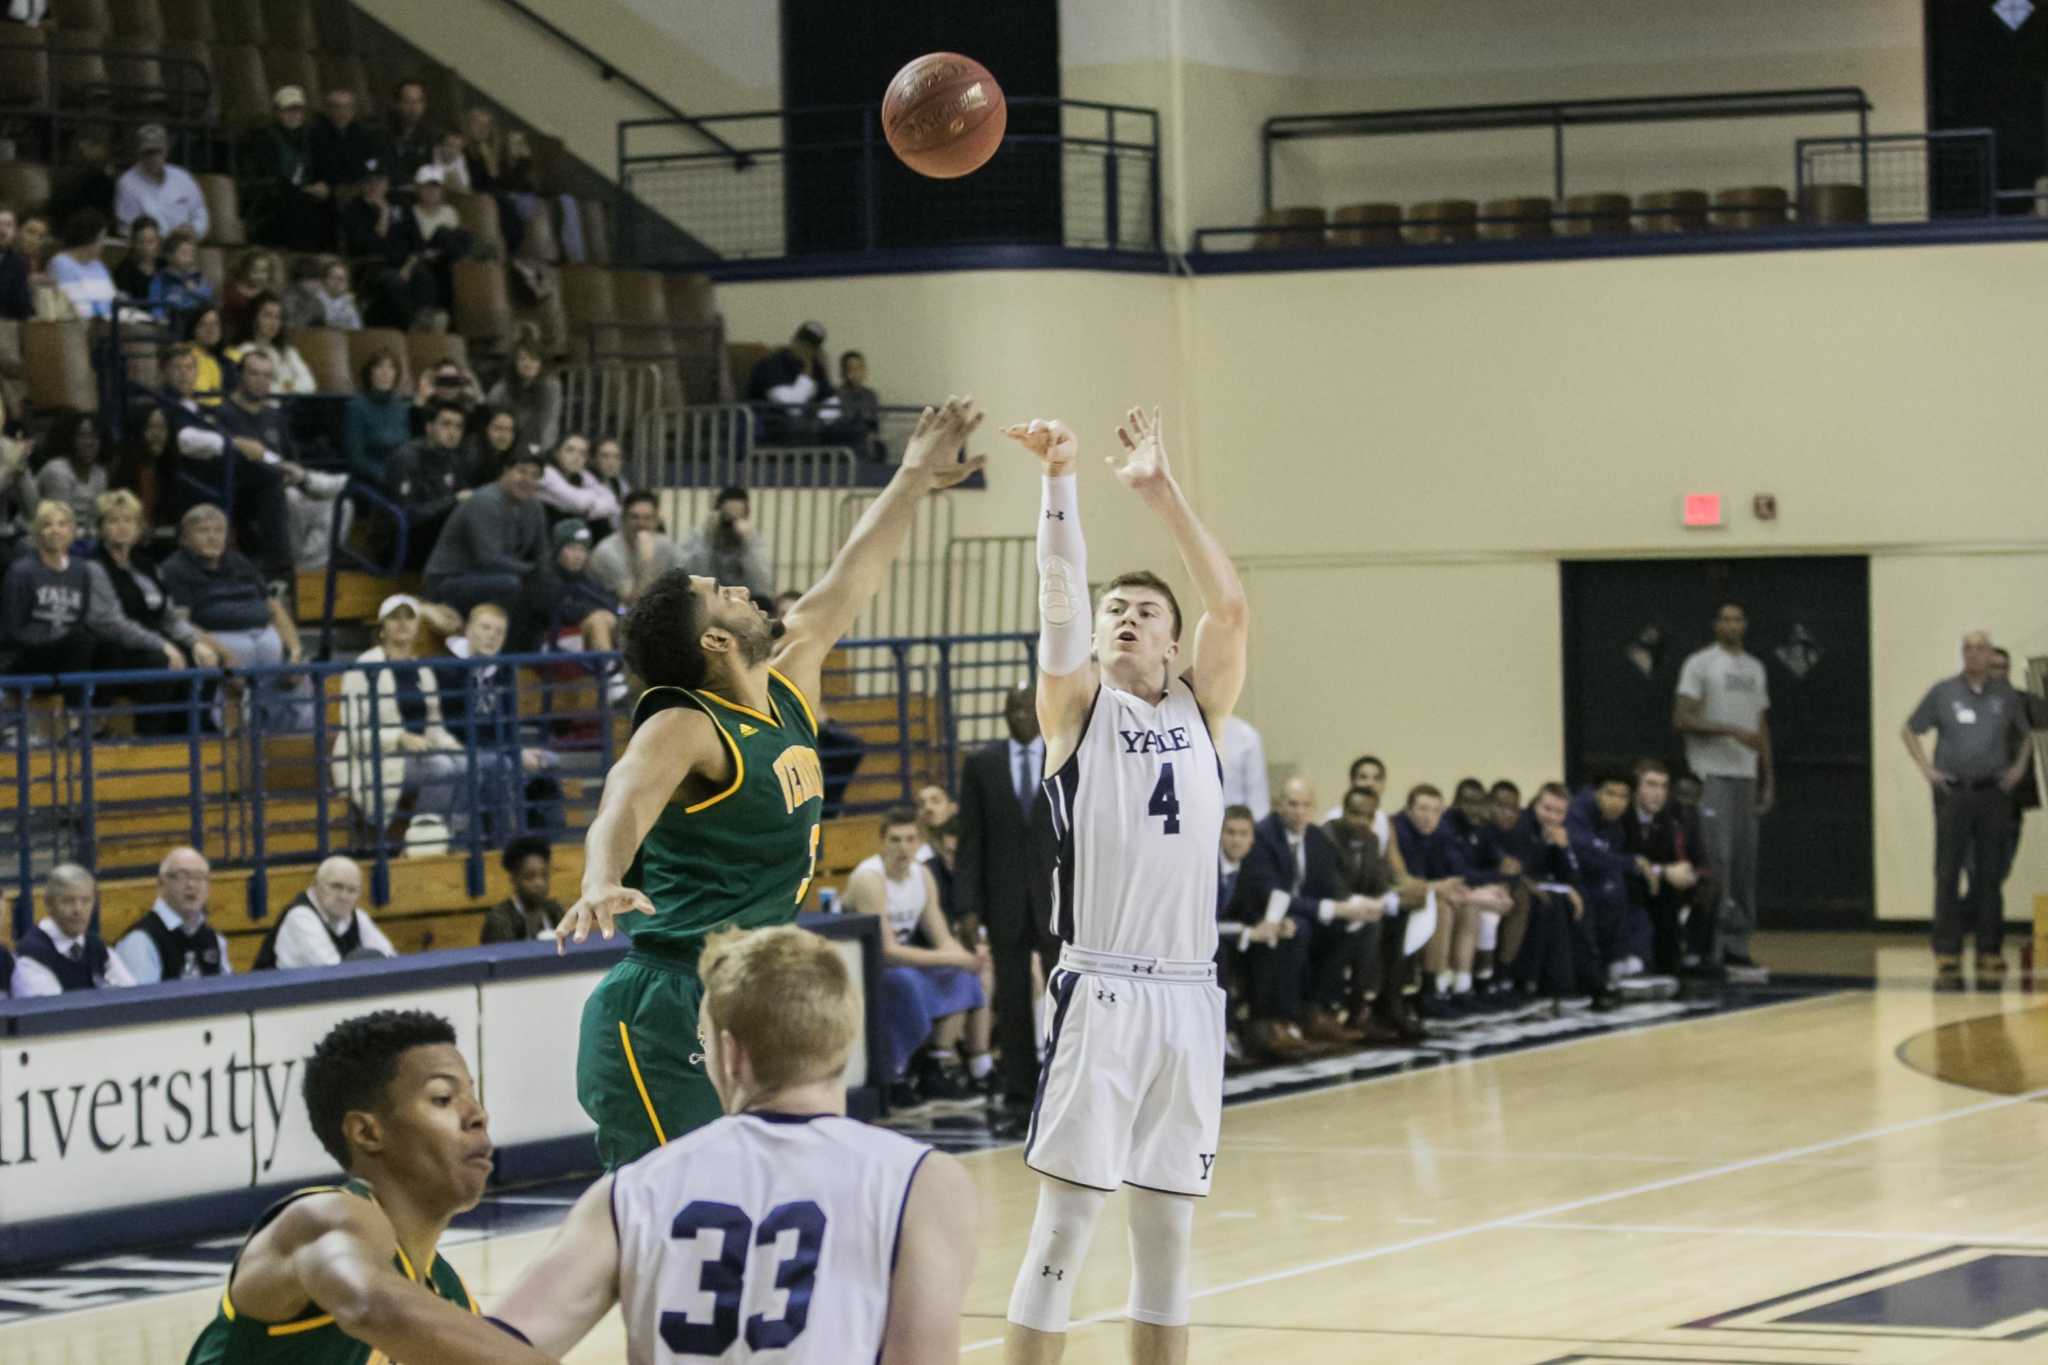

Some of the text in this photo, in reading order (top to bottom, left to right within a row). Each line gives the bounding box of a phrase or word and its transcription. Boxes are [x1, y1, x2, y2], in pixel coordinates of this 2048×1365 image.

[1120, 727, 1190, 754] YALE
[1148, 763, 1180, 834] 4
[0, 1031, 296, 1172] iversity
[1199, 1153, 1215, 1180] Y
[659, 1200, 827, 1356] 33
